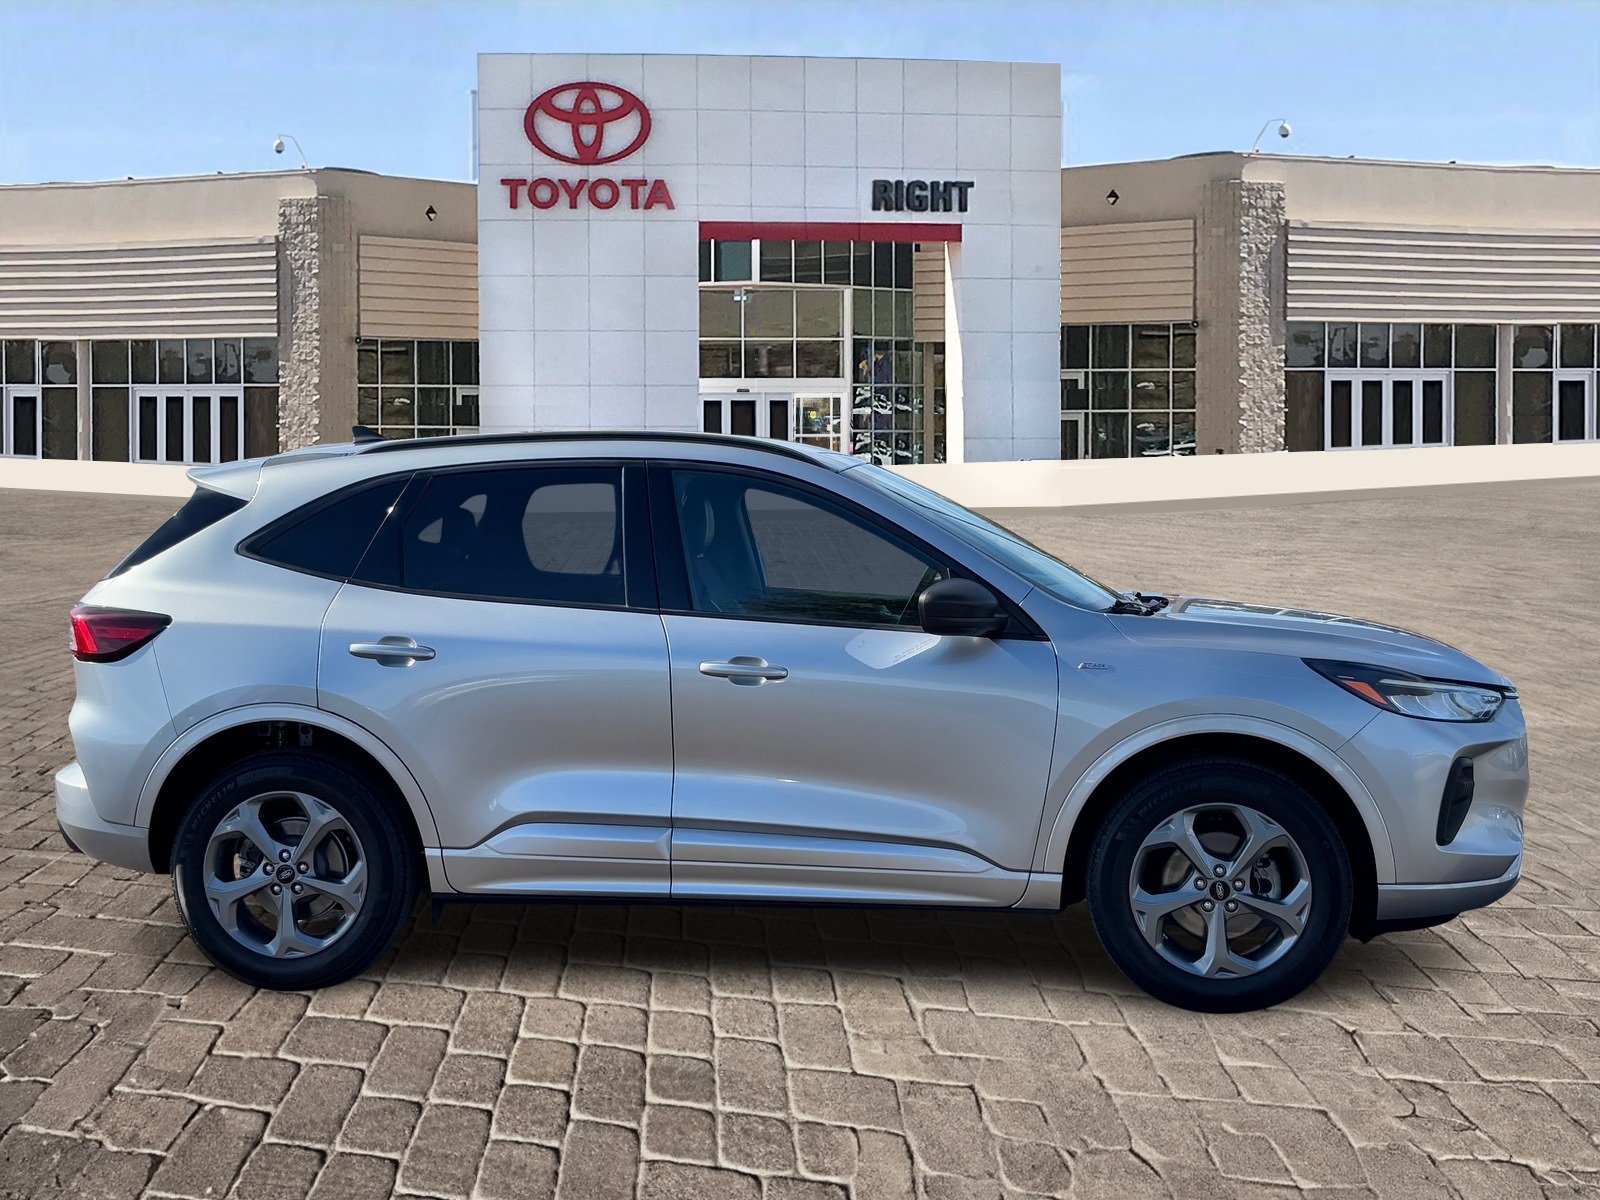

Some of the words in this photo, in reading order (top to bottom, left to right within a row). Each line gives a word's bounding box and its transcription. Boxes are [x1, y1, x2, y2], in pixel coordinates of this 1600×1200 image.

[500, 177, 676, 210] TOYOTA
[871, 179, 975, 212] RIGHT
[191, 780, 235, 831] MICHELIN
